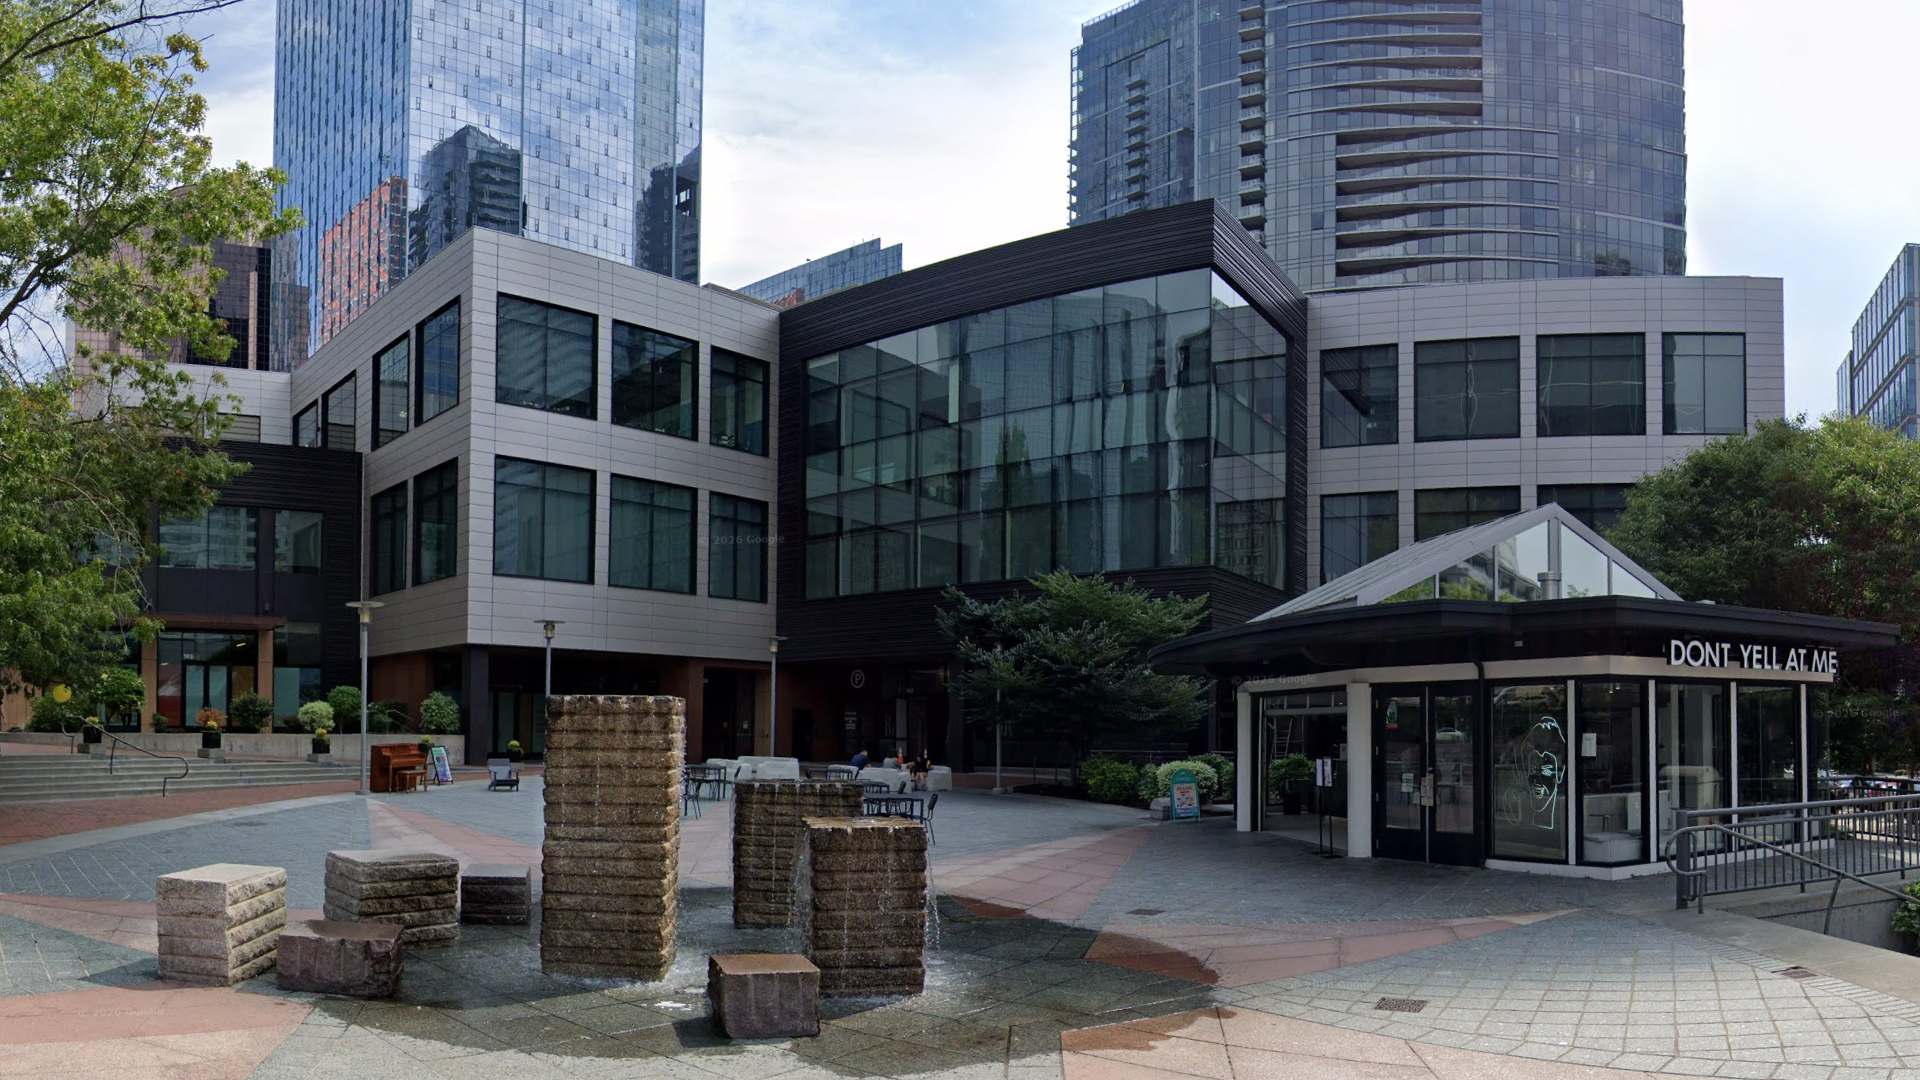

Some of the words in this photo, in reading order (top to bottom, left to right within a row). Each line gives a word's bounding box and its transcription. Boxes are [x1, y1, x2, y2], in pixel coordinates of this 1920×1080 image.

[1671, 640, 1731, 667] DONT
[1740, 644, 1780, 669] YELL
[1785, 648, 1807, 672] AT
[1811, 650, 1837, 674] ME
